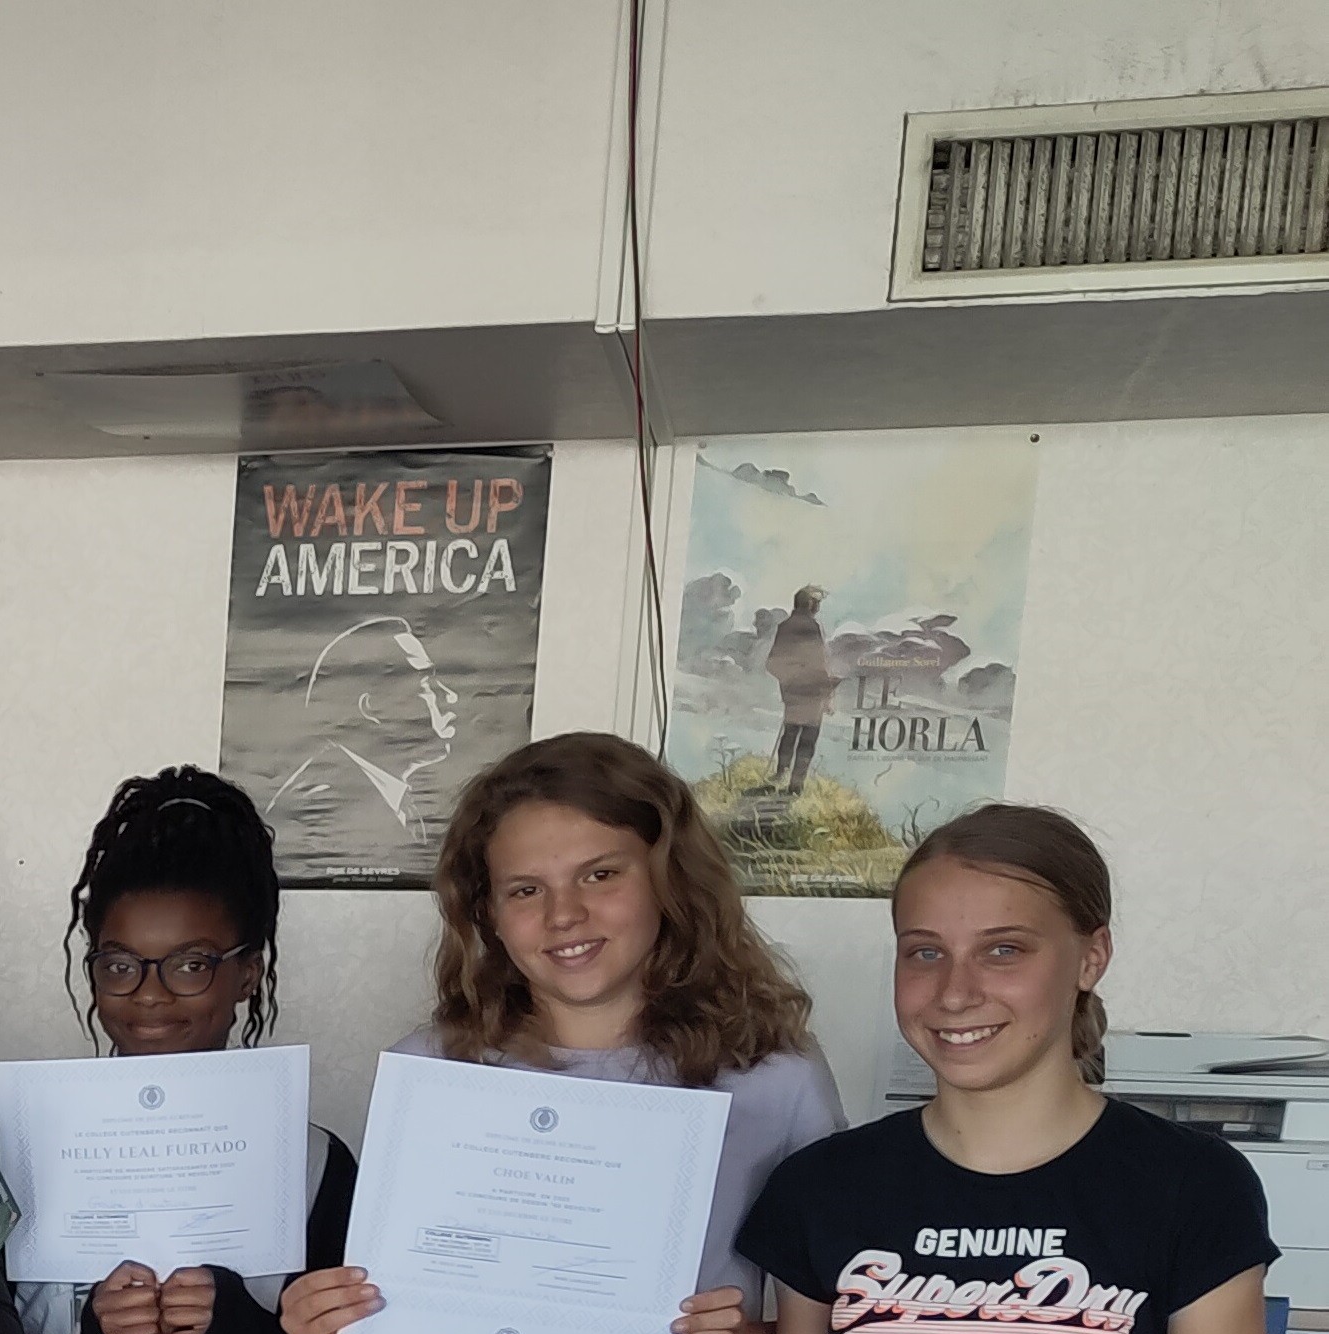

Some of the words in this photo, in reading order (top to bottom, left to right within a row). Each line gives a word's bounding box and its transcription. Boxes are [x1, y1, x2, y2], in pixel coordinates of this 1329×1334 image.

[263, 480, 429, 538] WAKE
[445, 478, 523, 534] UP
[255, 538, 517, 597] AMERICA
[852, 675, 903, 711] LE
[847, 716, 990, 752] HORLA
[61, 1147, 113, 1160] NELLY
[119, 1145, 160, 1158] LEAL
[166, 1139, 248, 1156] FURTADO
[535, 1171, 576, 1186] VALIN
[914, 1227, 1067, 1258] GENUINE
